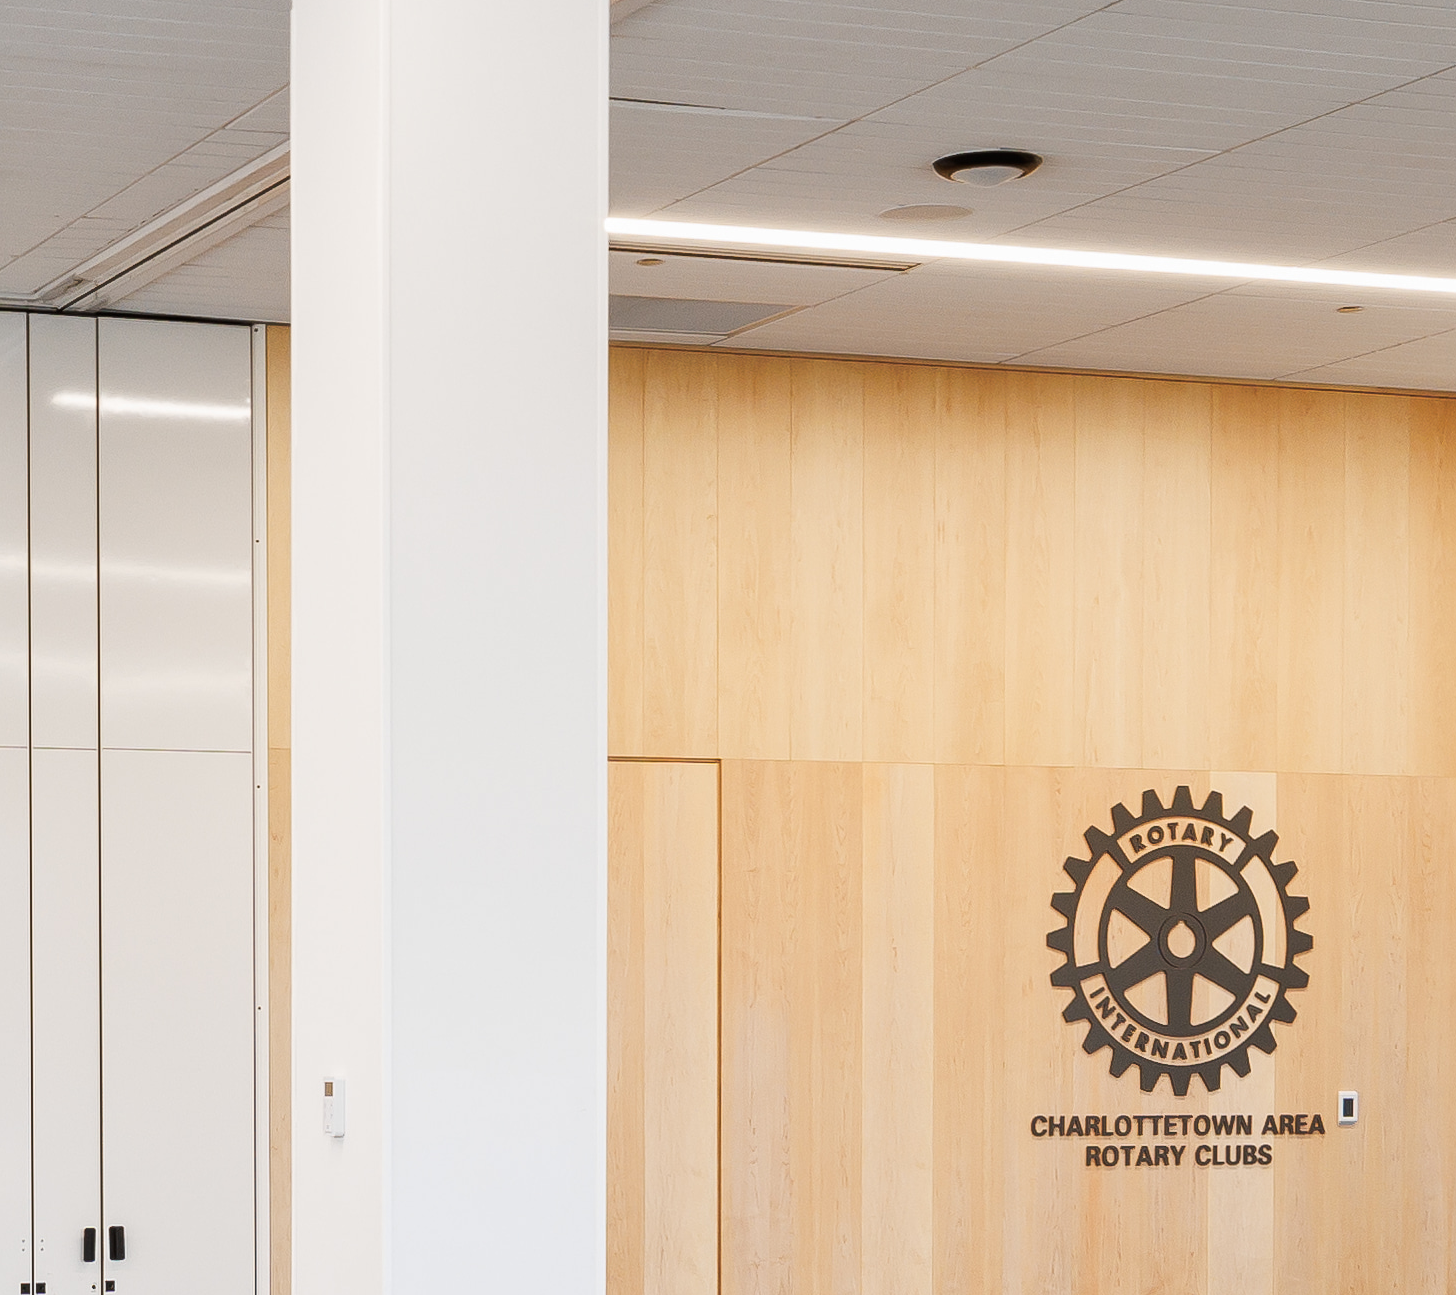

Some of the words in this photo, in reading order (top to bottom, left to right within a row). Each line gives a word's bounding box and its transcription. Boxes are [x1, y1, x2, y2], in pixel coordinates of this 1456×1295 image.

[1129, 822, 1234, 853] ROTARY
[1089, 986, 1271, 1060] INTERNATIONAL
[1031, 1115, 1253, 1137] CHARLOTTETOWN
[1261, 1114, 1325, 1135] AREA
[1086, 1145, 1186, 1166] ROTARY
[1195, 1145, 1273, 1166] CLUBS
